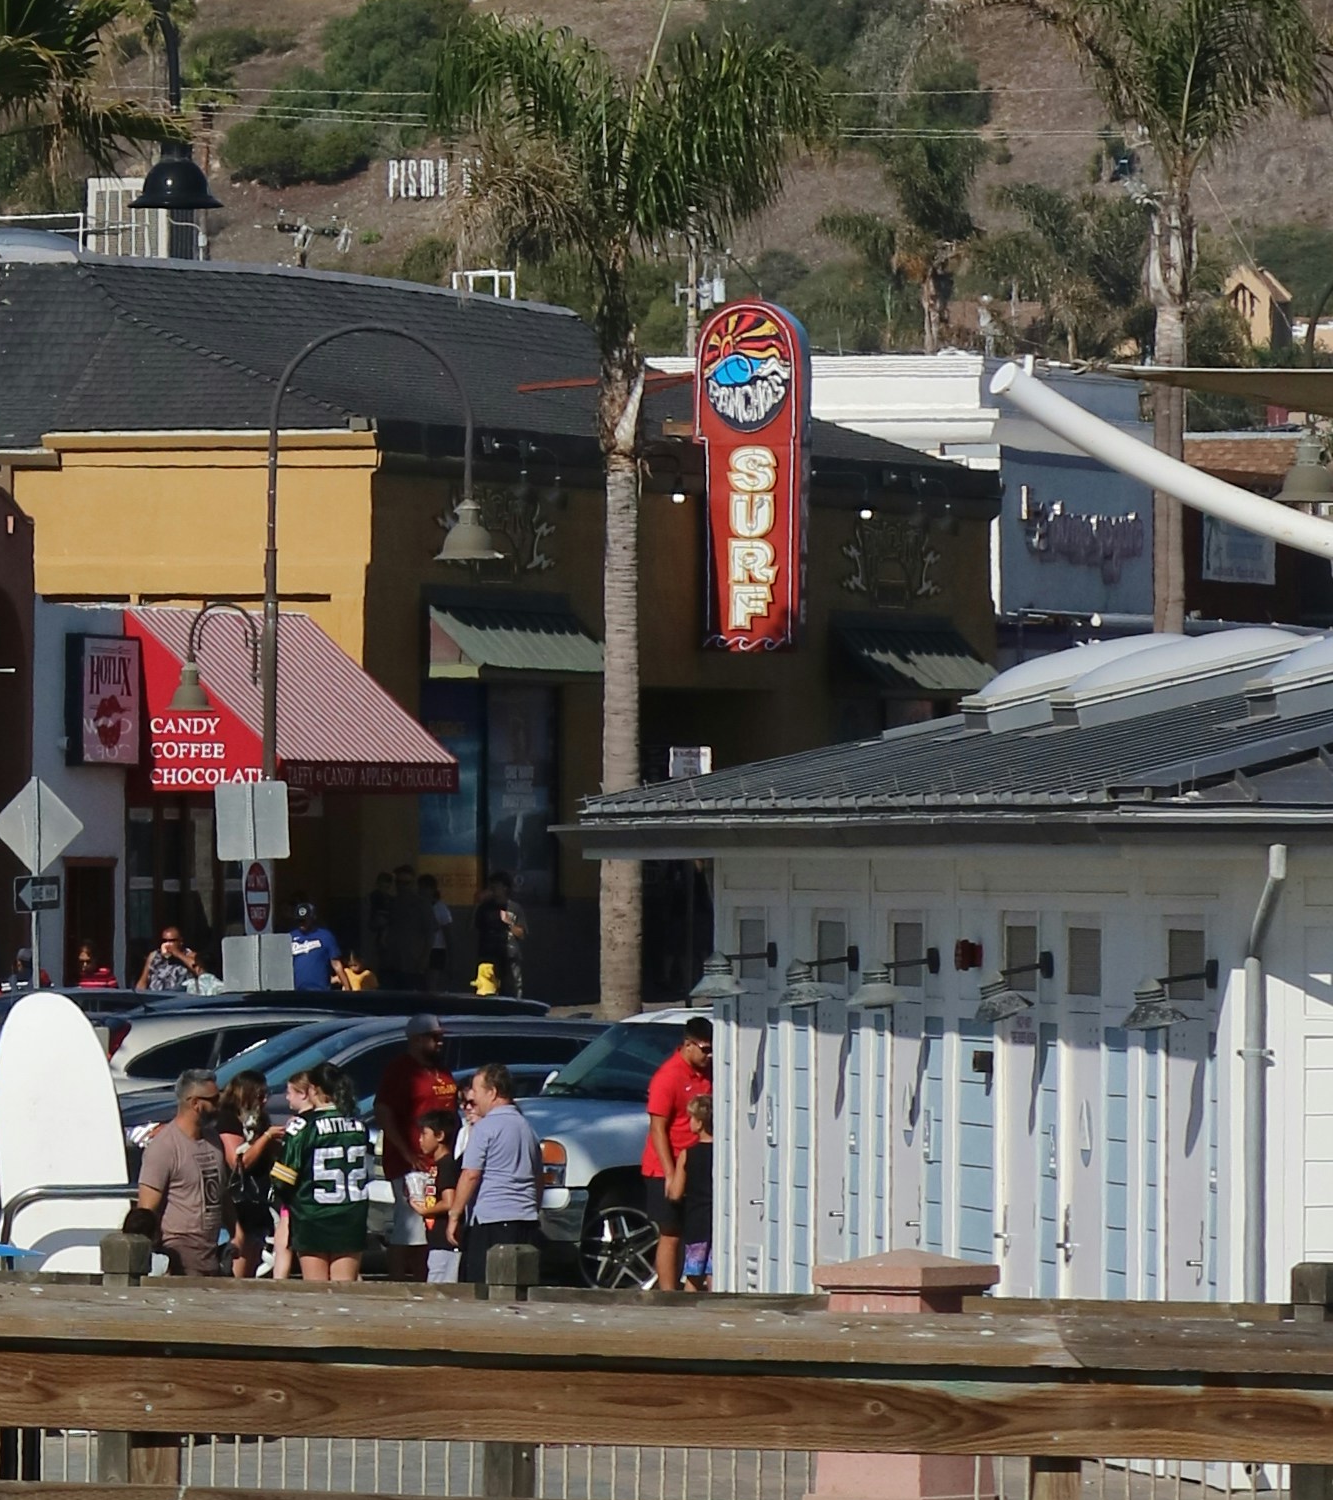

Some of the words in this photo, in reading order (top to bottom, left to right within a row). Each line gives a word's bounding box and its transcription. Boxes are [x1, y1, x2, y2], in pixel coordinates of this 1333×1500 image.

[388, 158, 448, 198] PISMO
[727, 445, 778, 630] SURF
[90, 655, 132, 697] HOTLIX
[150, 717, 221, 735] CANDY
[150, 742, 226, 760] COFFEE
[286, 765, 314, 785] TAFFY
[323, 766, 356, 786] CANDY
[359, 766, 392, 787] APPLES
[399, 767, 453, 788] CHOCOLATE
[313, 1145, 368, 1204] 52
